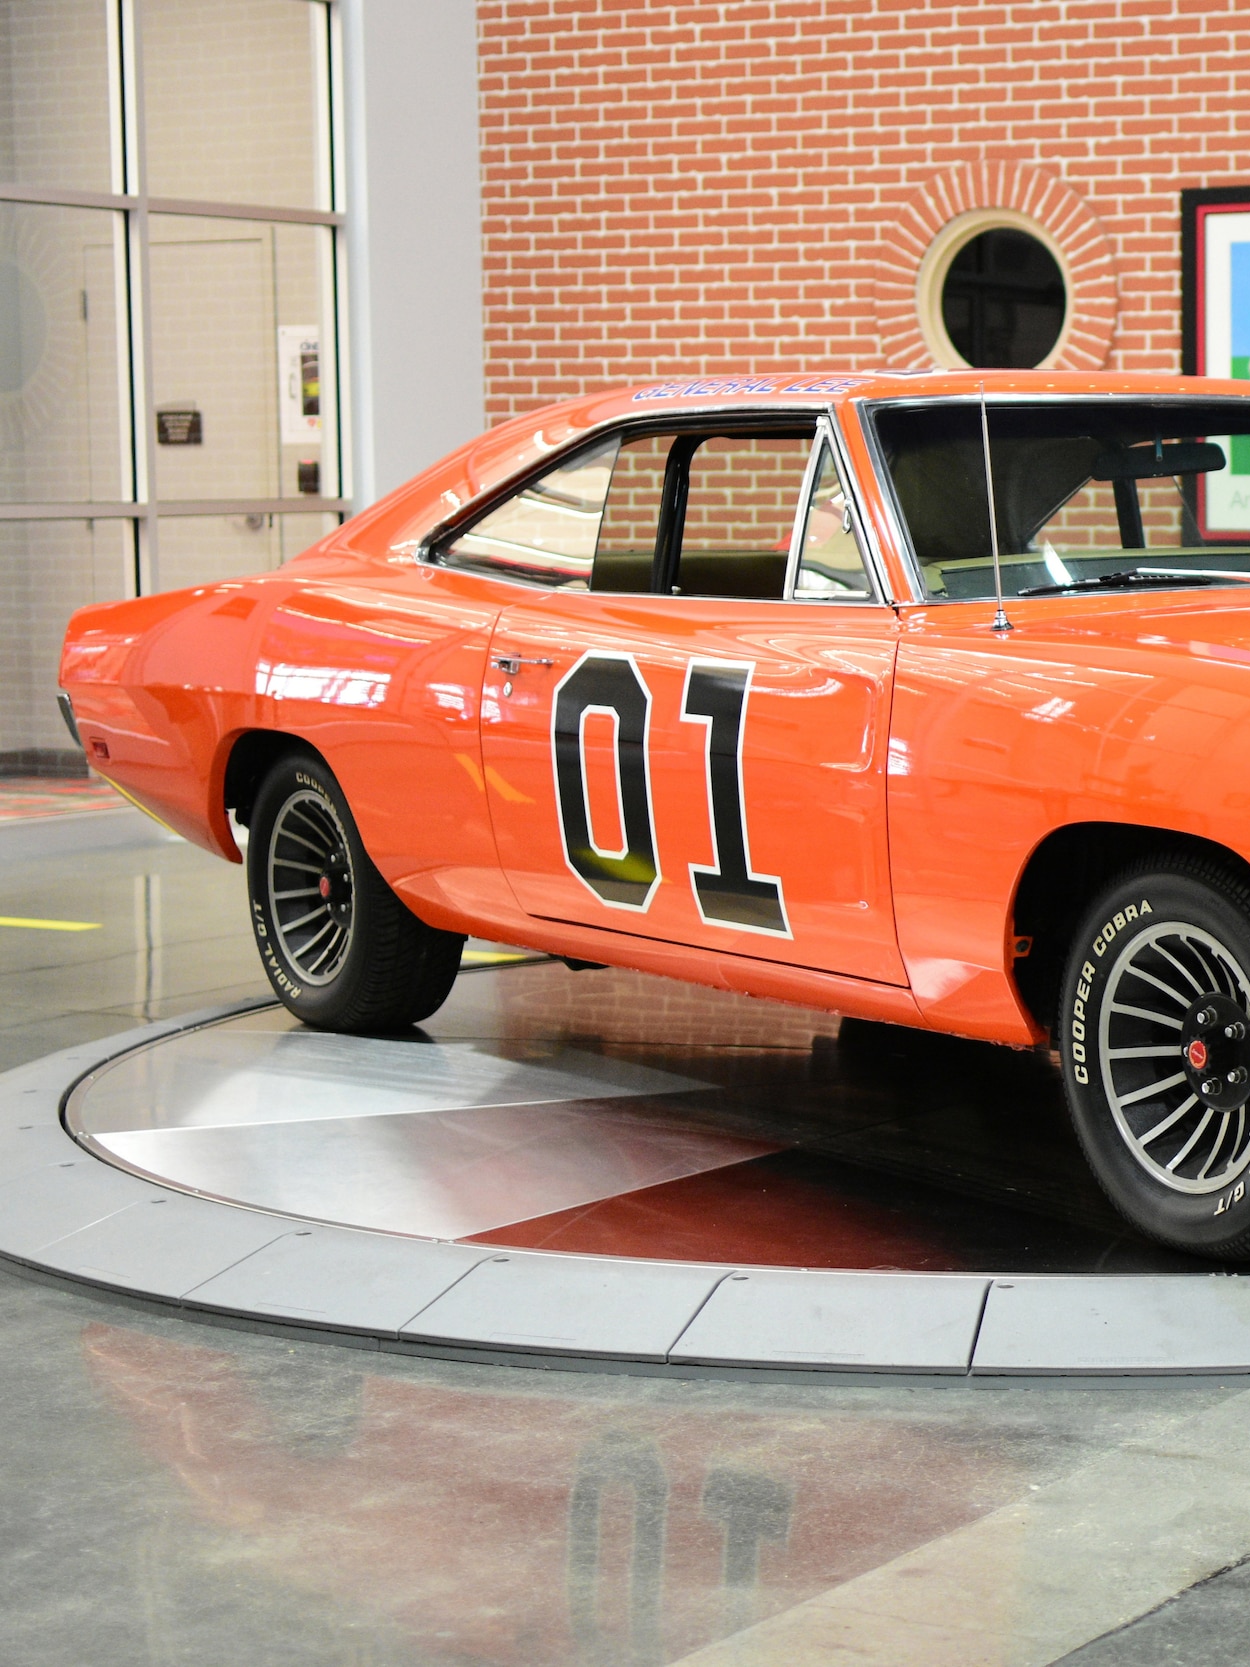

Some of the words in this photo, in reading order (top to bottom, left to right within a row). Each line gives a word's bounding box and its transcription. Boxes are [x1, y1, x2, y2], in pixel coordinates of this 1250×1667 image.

[633, 378, 785, 401] GENERAL
[779, 377, 875, 394] LEE
[551, 649, 794, 940] 01
[260, 942, 302, 1000] RADIAL
[1073, 961, 1096, 1086] COOPER
[1093, 899, 1154, 959] COBRA
[1213, 1181, 1245, 1216] G/T
